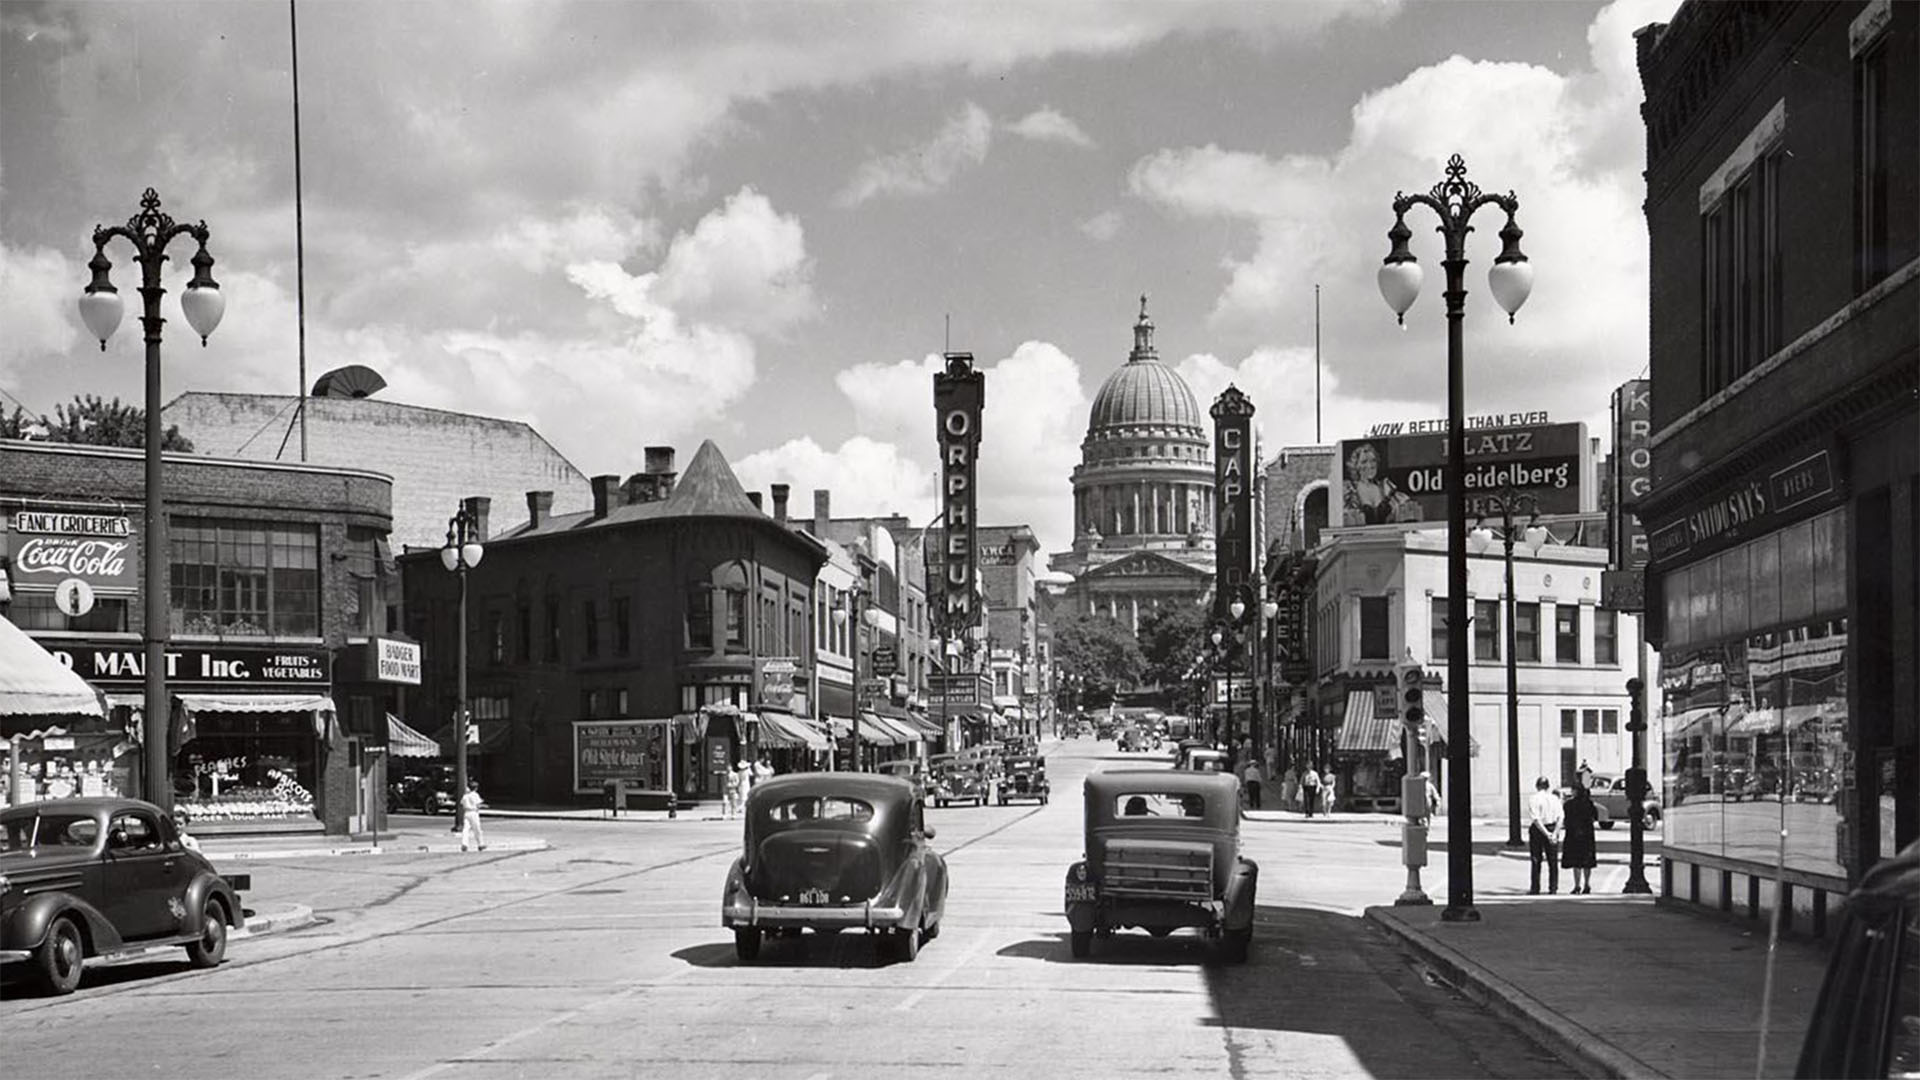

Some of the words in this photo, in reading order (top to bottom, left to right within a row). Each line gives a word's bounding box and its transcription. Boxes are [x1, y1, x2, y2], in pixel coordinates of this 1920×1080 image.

[1370, 423, 1404, 437] NOW
[1409, 419, 1450, 434] BETTE
[1468, 416, 1503, 430] THAN
[1510, 411, 1548, 427] EVER
[1408, 469, 1443, 492] Old
[1463, 463, 1569, 490] eidelberg
[18, 513, 58, 532] FANCY
[60, 515, 128, 535] GROCERIES
[946, 410, 969, 614] ORPHEUM
[17, 538, 129, 576] Coca-Cola
[94, 651, 183, 678] MAT
[201, 653, 250, 678] Inc.
[274, 655, 310, 667] FRUITS
[385, 644, 414, 661] BADGER
[262, 667, 323, 679] VEGETABLES
[380, 660, 400, 676] FOOD
[401, 662, 419, 679] MART
[194, 756, 247, 777] PEAHES
[267, 768, 313, 802] APRICOTS
